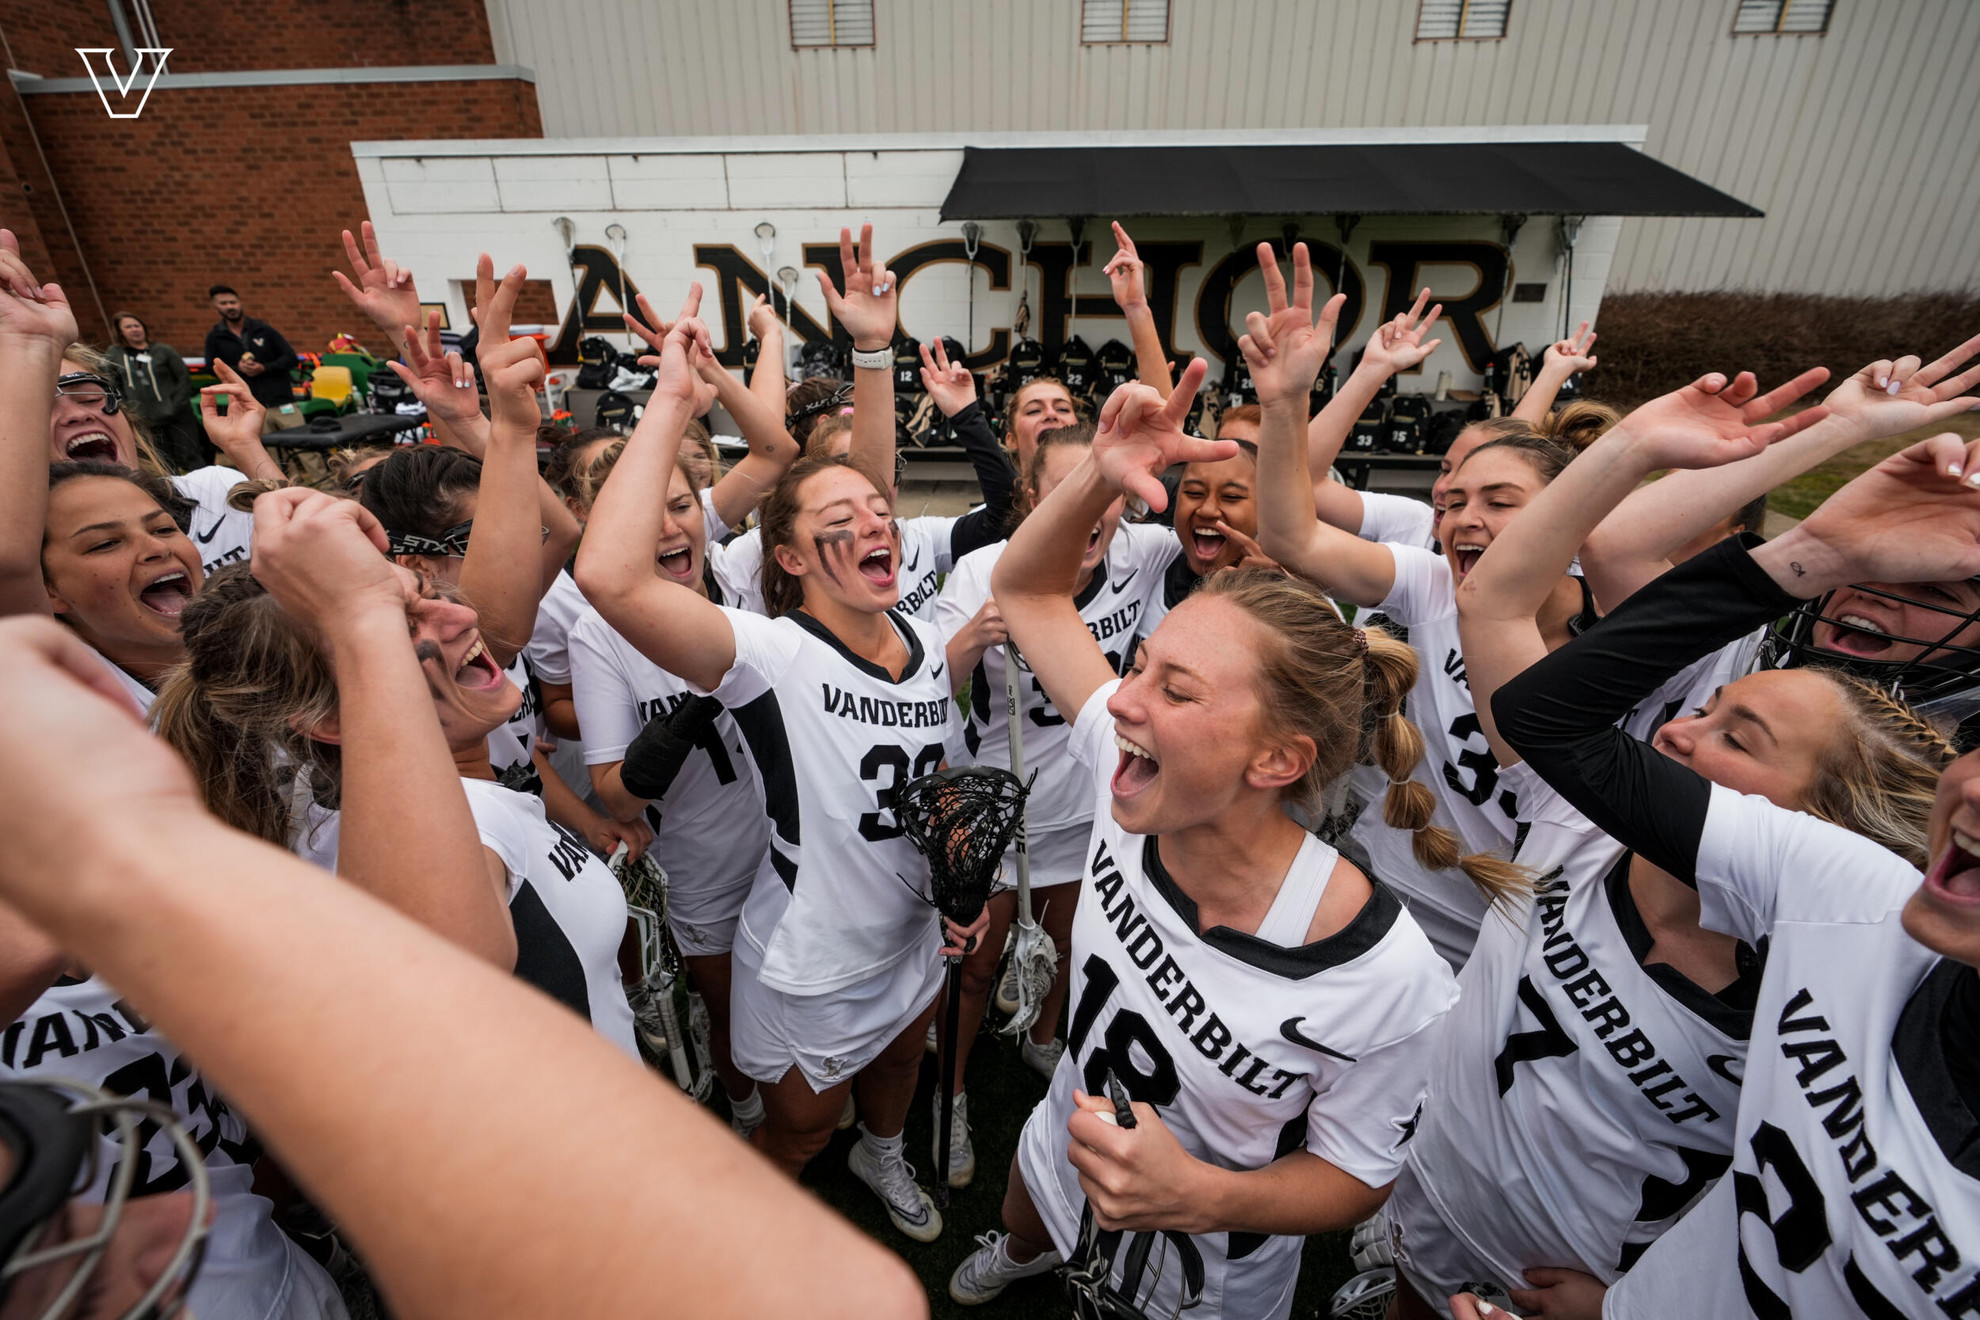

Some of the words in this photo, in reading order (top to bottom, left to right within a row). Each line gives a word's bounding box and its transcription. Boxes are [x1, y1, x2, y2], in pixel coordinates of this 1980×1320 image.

[547, 237, 1515, 375] ANCHOR
[900, 370, 913, 382] 12
[1067, 374, 1083, 385] 22
[403, 534, 449, 554] STX
[1442, 712, 1519, 820] 3
[1091, 838, 1303, 1100] VANDERBILT
[1533, 864, 1721, 1125] VANDERBILT
[1494, 974, 1580, 1100] 7
